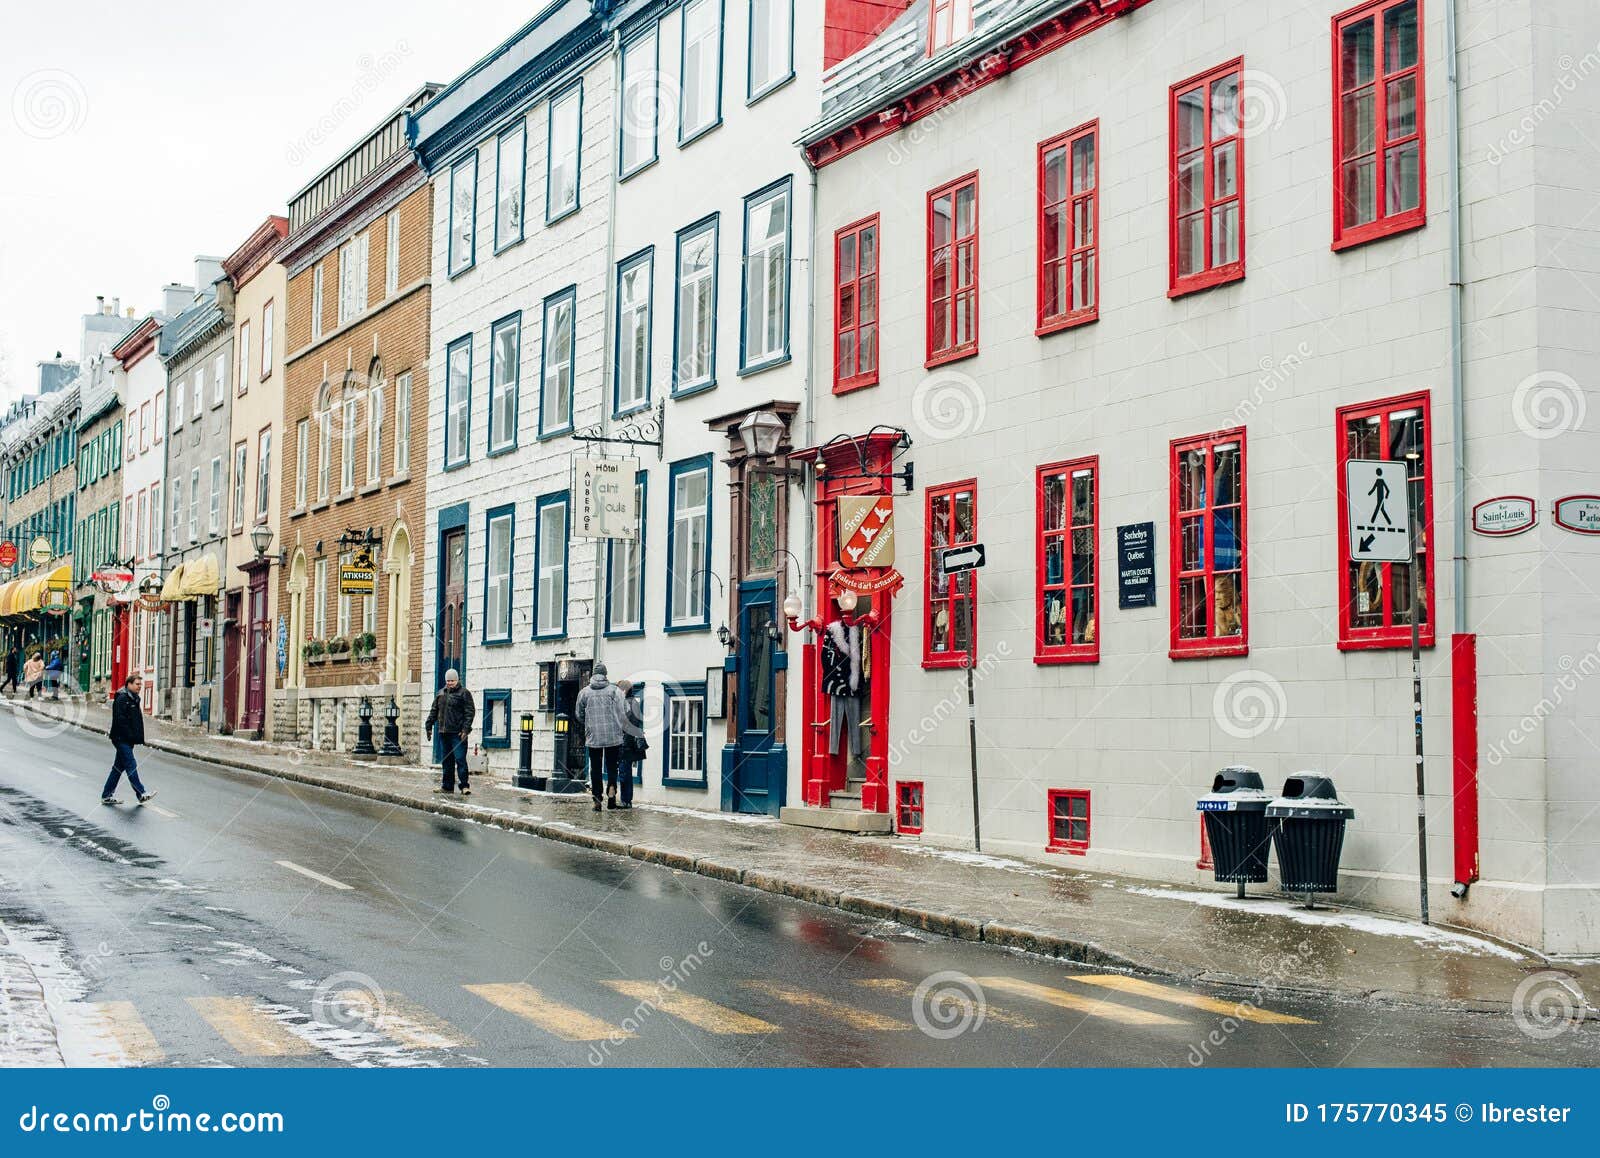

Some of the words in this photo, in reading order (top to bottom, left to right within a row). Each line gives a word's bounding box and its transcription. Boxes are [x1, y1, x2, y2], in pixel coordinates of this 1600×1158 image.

[595, 464, 618, 473] Hôtel
[583, 471, 591, 531] AUBERGE
[844, 507, 866, 532] Trois
[1483, 508, 1525, 522] Saint-Louis
[864, 527, 894, 566] Colombes
[835, 573, 857, 587] galerie
[1122, 569, 1136, 578] MARTIN
